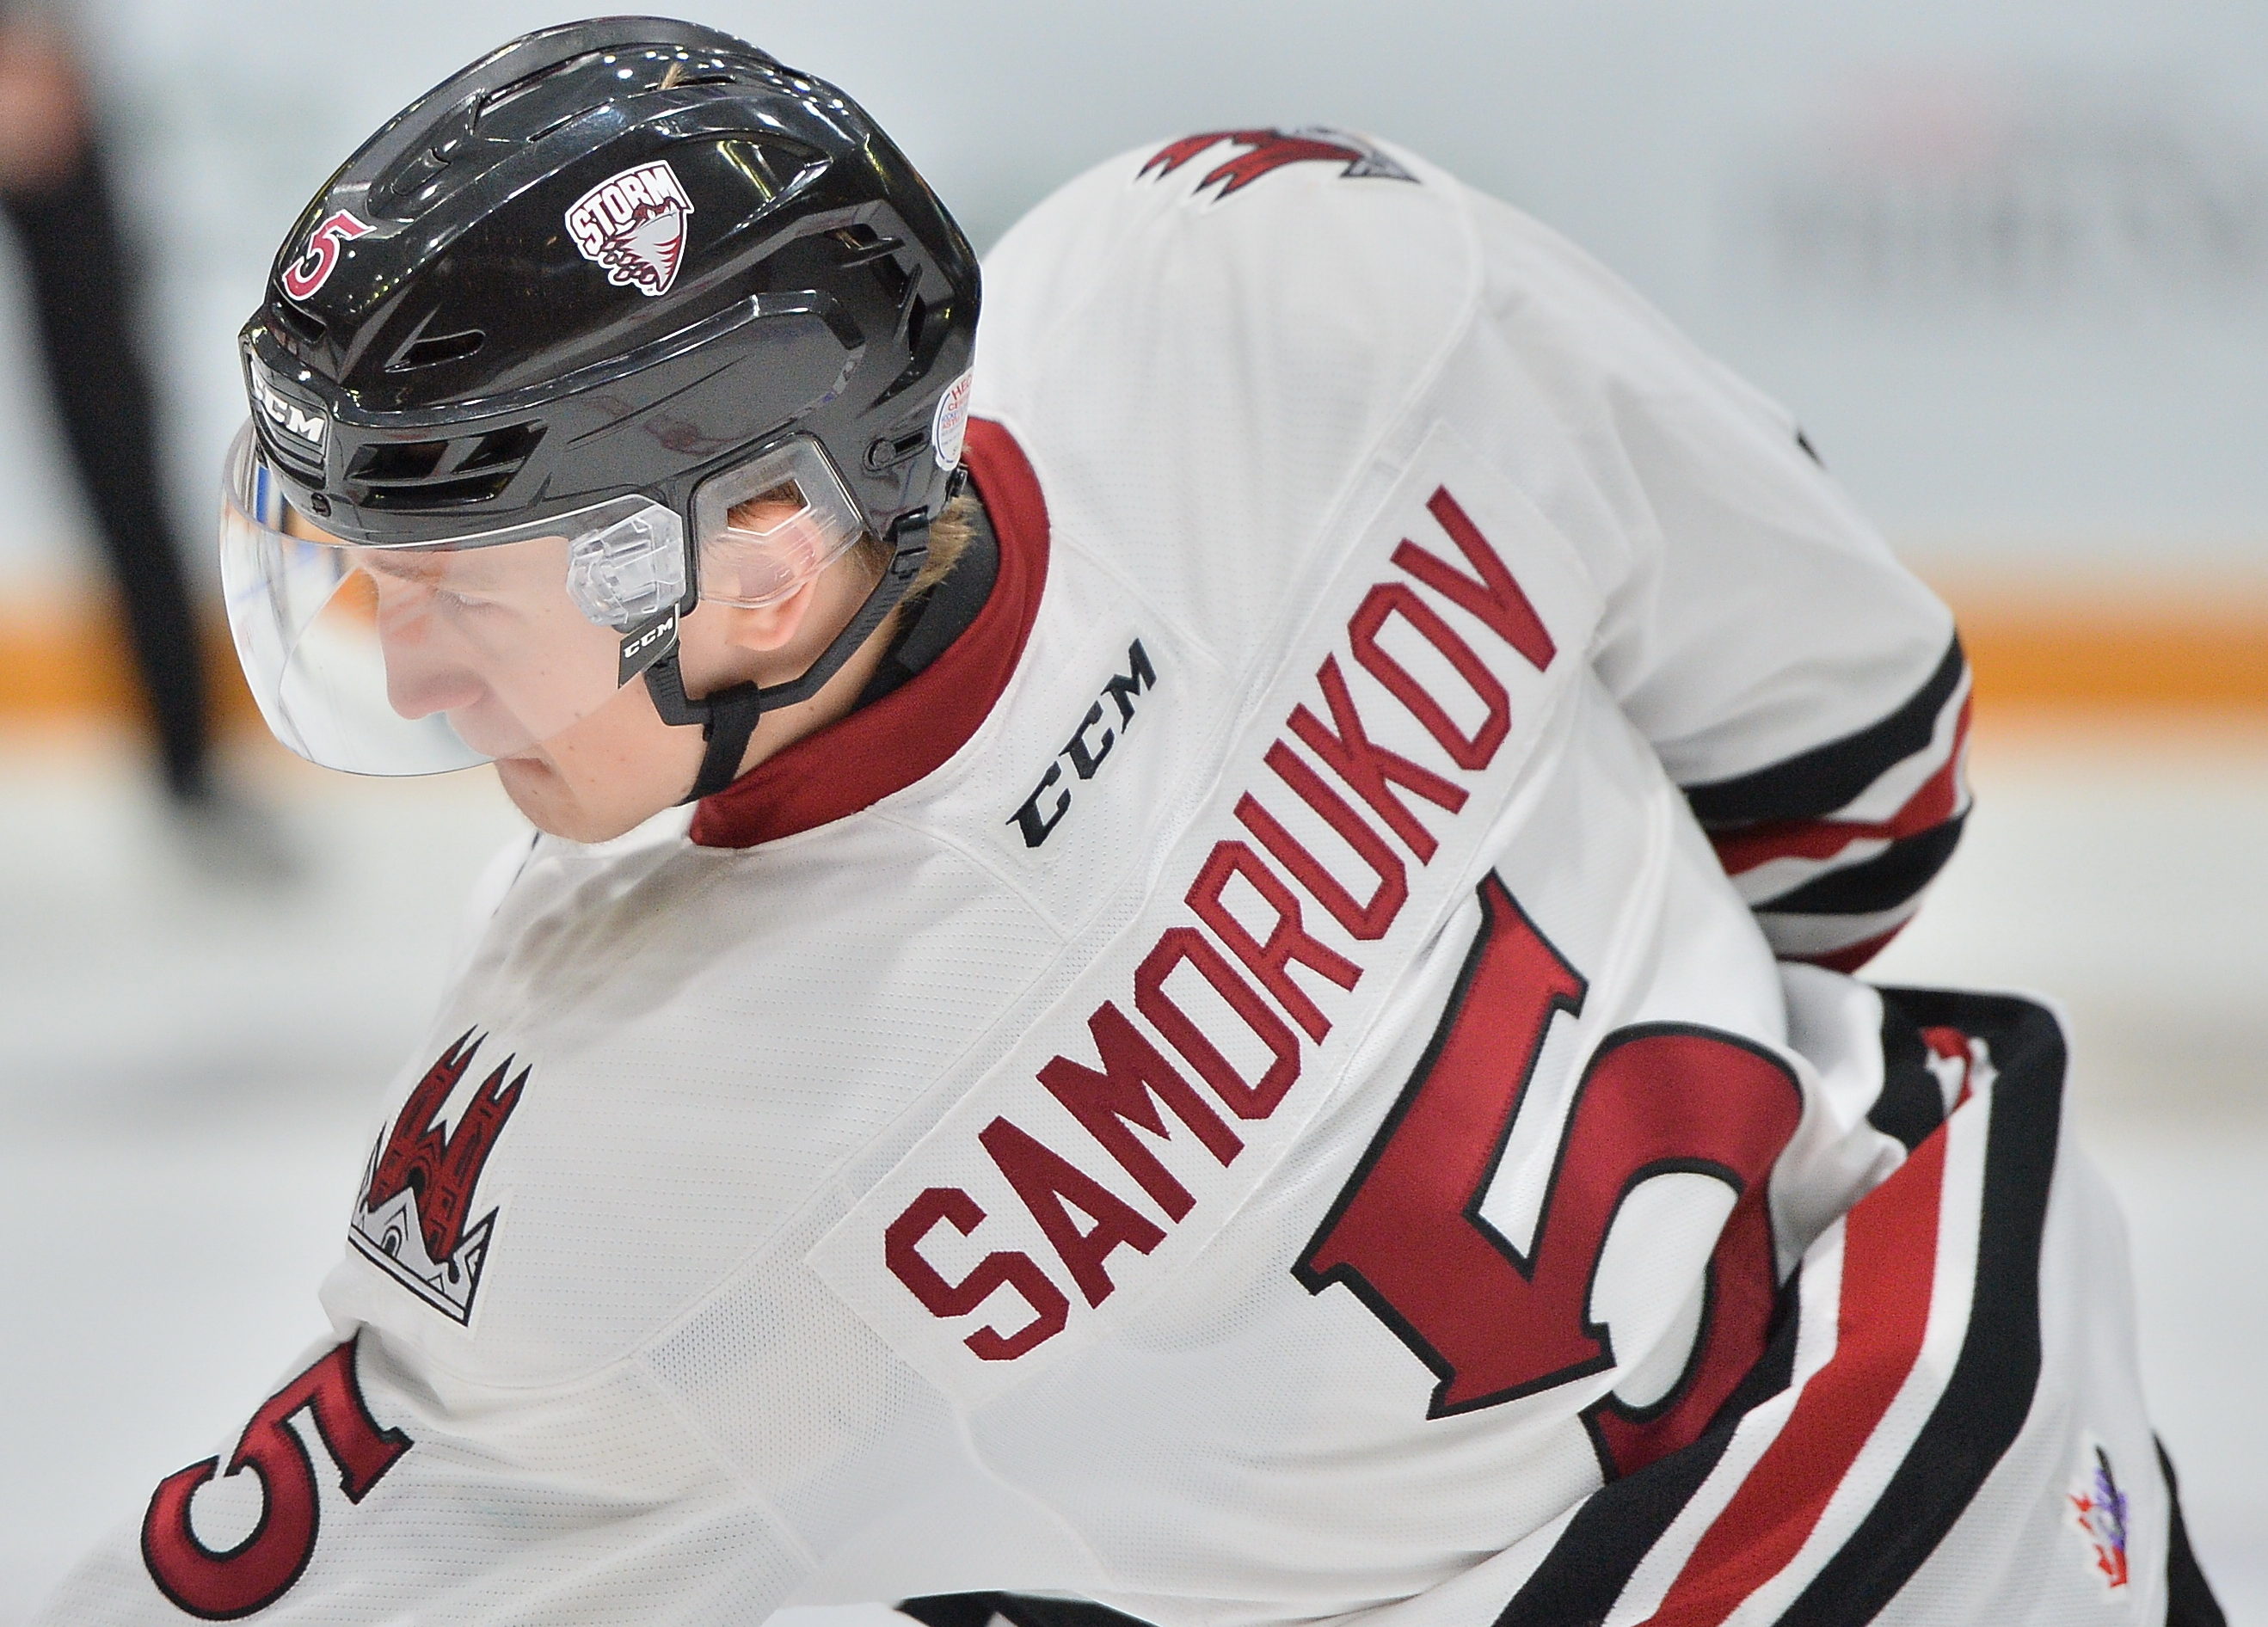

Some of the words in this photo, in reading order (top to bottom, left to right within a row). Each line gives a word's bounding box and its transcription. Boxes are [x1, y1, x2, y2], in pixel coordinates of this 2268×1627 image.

[282, 209, 378, 301] 5
[570, 165, 688, 256] STORM
[624, 617, 673, 659] CCM
[1005, 637, 1158, 848] CCM
[884, 485, 1557, 1360] SAMORUKOV
[1290, 867, 1804, 1485] 5
[140, 1326, 415, 1621] 5
